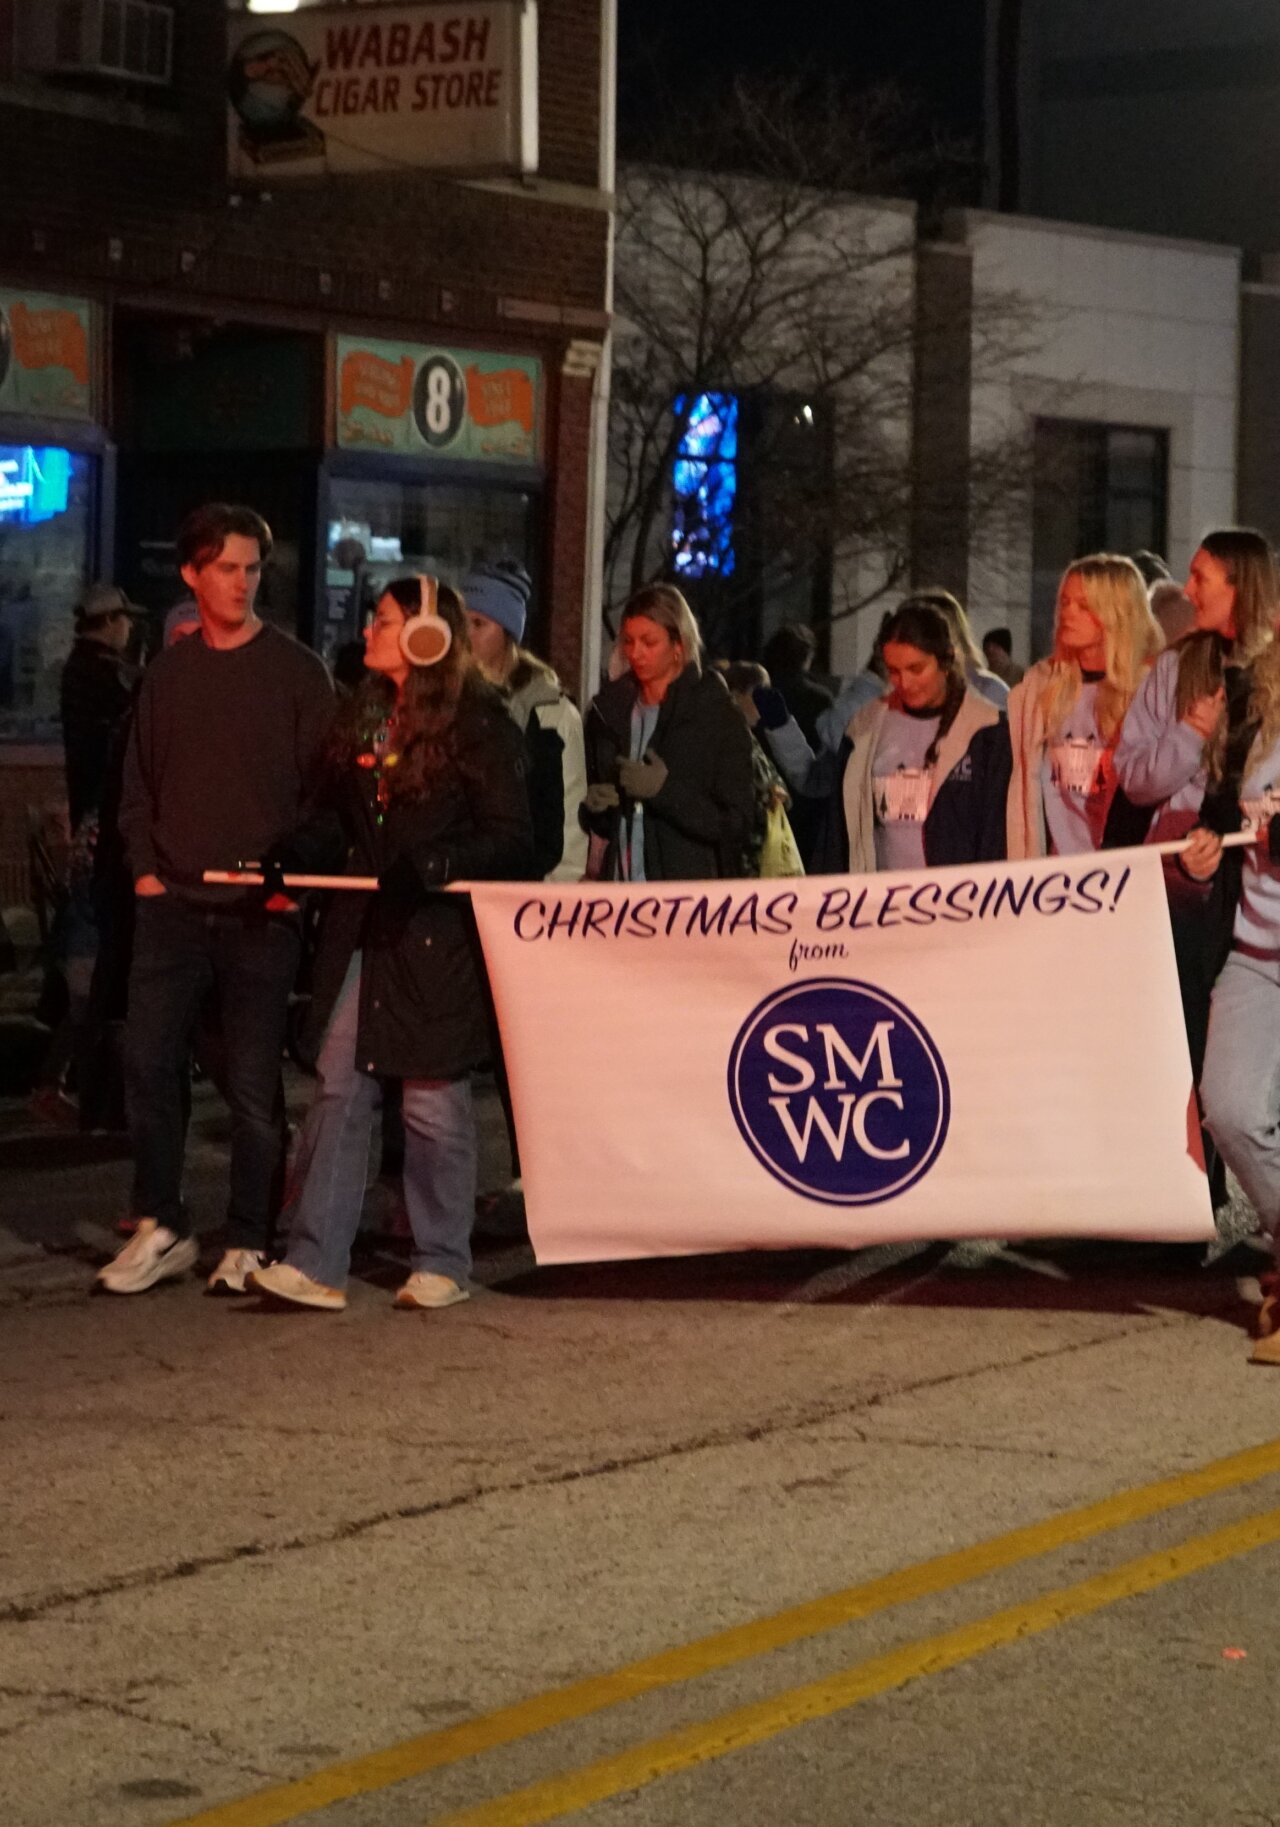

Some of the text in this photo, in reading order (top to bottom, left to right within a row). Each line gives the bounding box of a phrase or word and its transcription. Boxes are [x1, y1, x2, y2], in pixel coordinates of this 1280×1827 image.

[326, 17, 490, 70] WABASH
[314, 69, 502, 117] CIGAR STORE
[425, 365, 450, 434] 8
[513, 866, 1131, 942] CHRISTMAS BLESSINGS!
[789, 937, 849, 972] from
[763, 1020, 903, 1094] SM
[768, 1090, 910, 1164] WC
